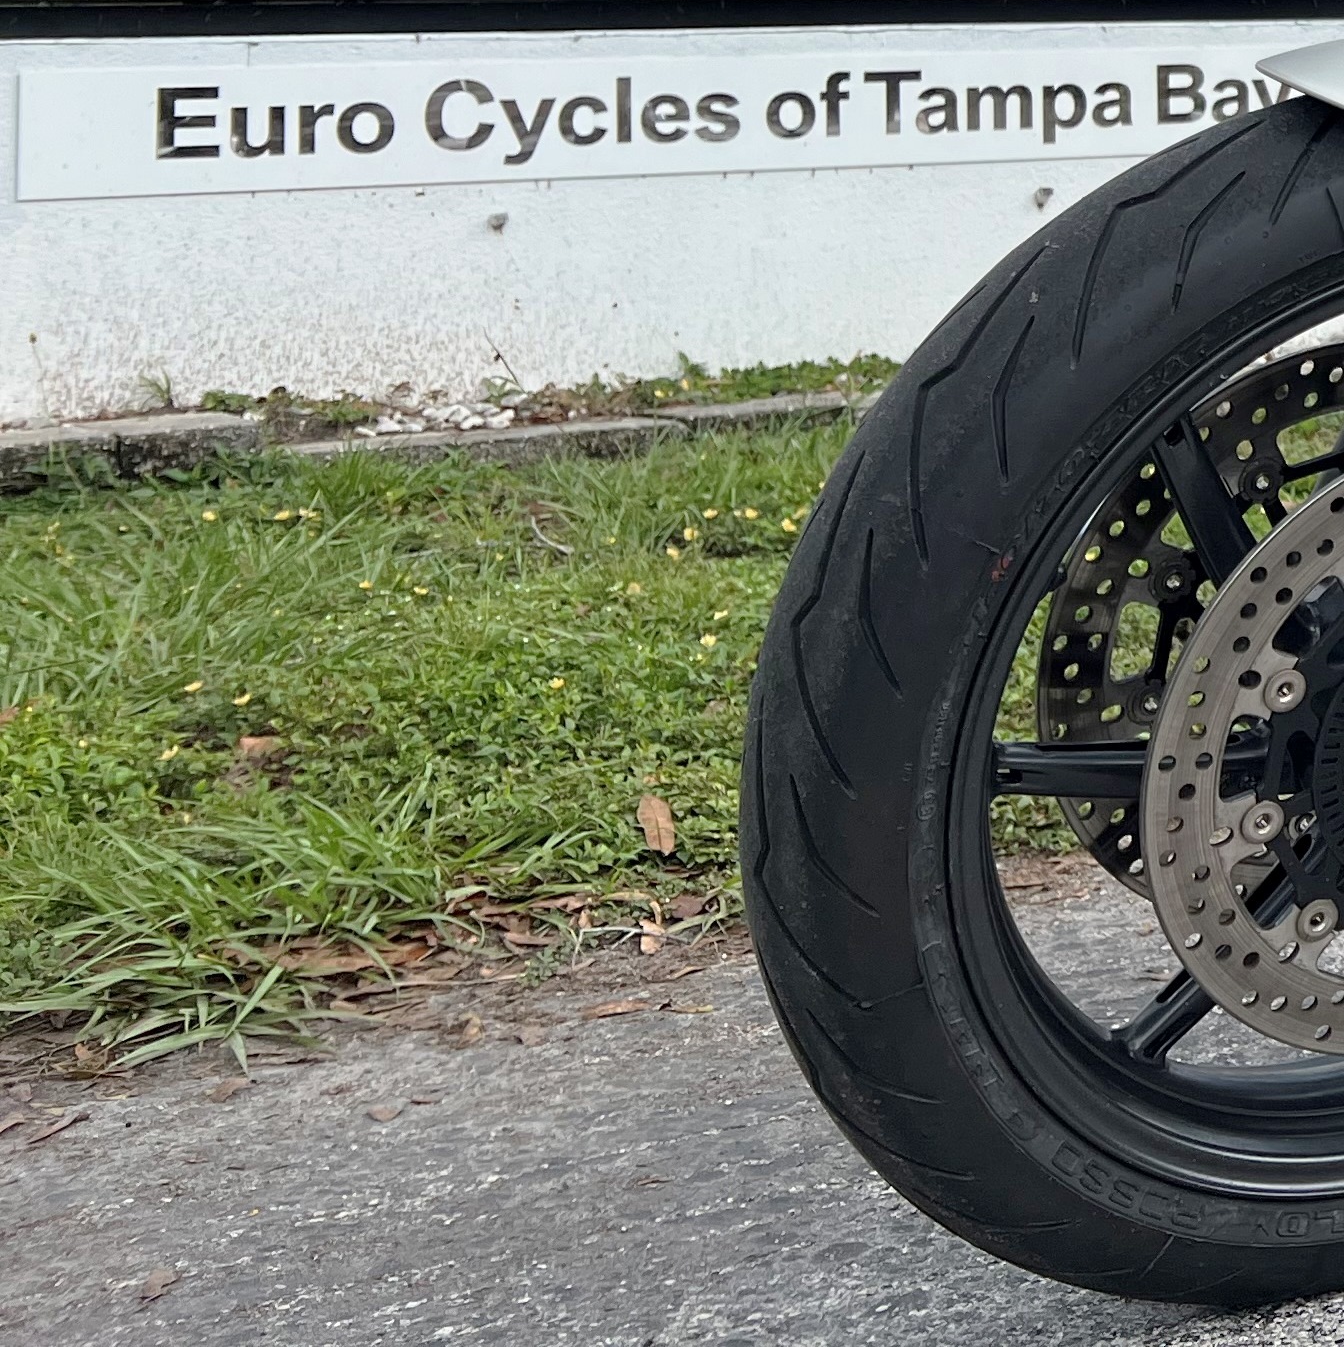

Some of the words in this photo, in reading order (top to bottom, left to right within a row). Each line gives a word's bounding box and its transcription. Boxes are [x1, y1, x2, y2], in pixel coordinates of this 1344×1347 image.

[156, 86, 395, 160] Euro
[425, 77, 741, 165] Cycles
[766, 71, 851, 139] of
[863, 69, 1132, 144] Tampa
